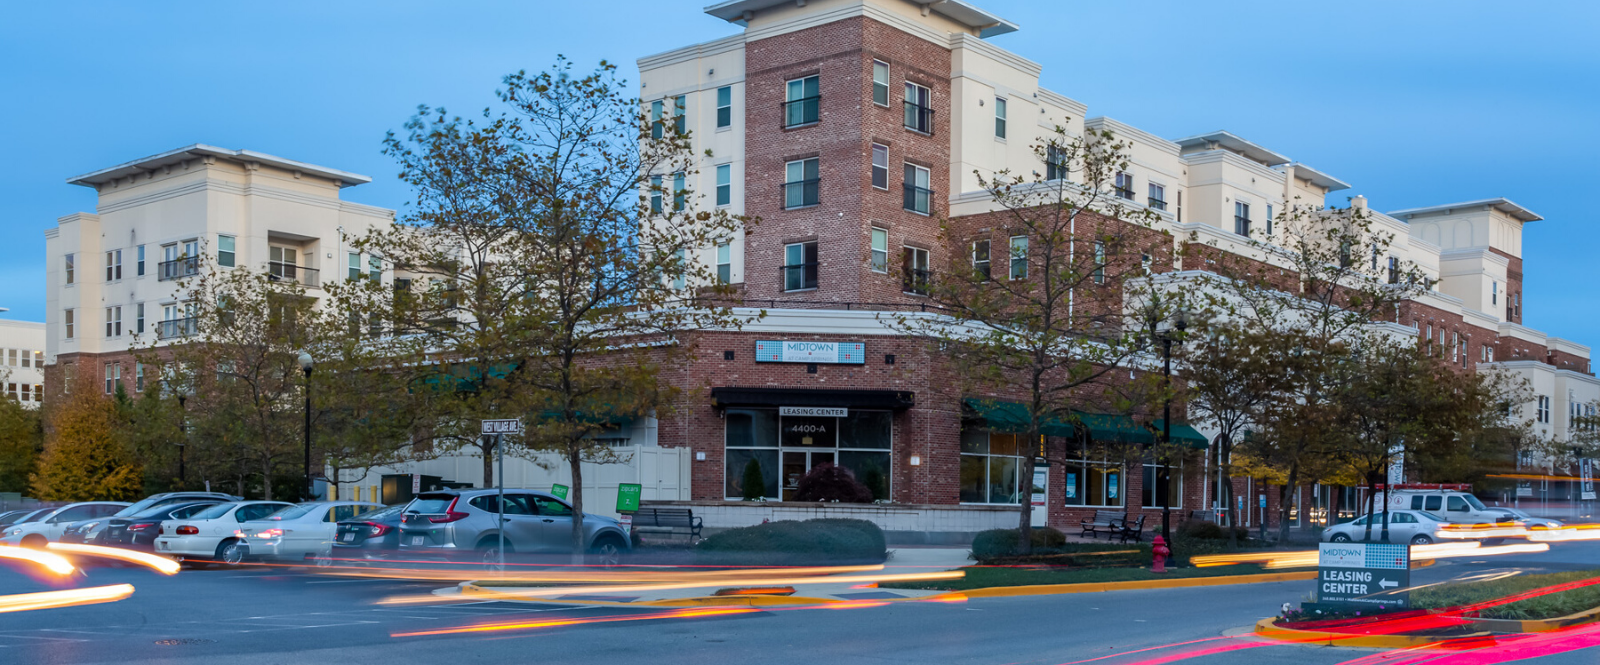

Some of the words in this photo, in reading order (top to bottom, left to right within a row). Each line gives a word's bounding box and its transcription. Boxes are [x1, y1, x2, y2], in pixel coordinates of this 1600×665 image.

[787, 342, 834, 352] MIDTOWN
[483, 421, 494, 432] WEST
[494, 421, 509, 432] VILLAGE
[792, 424, 826, 433] 4400-A
[1323, 548, 1362, 556] MIDTOWN
[1323, 570, 1372, 582] LEASING
[1322, 582, 1368, 595] CENTER
